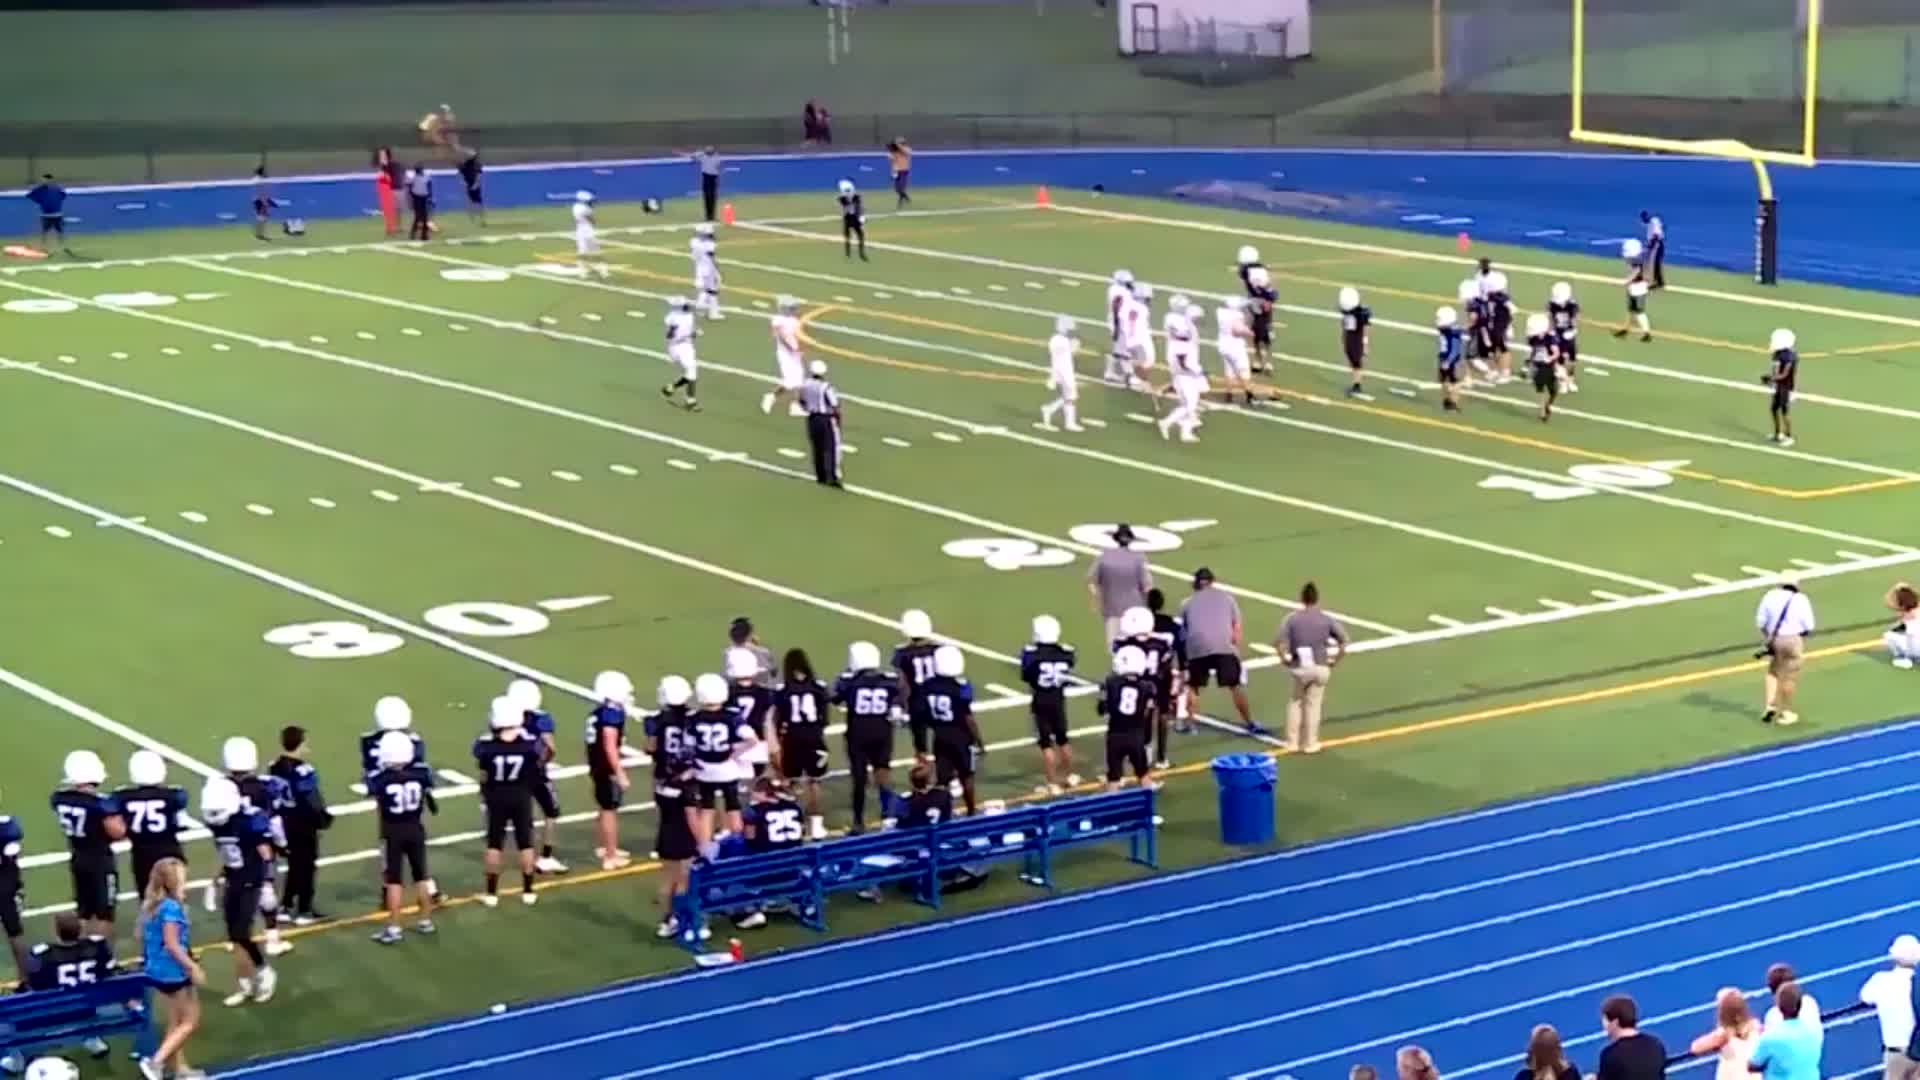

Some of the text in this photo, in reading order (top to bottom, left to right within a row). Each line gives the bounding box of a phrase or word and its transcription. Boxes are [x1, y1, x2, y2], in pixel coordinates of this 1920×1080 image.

[790, 692, 818, 723] 14
[855, 687, 889, 715] 66
[1119, 685, 1139, 715] 8
[696, 722, 730, 753] 32
[492, 754, 524, 782] 17
[386, 781, 421, 814] 30
[57, 804, 87, 838] 57
[126, 799, 167, 833] 75
[765, 809, 802, 843] 25
